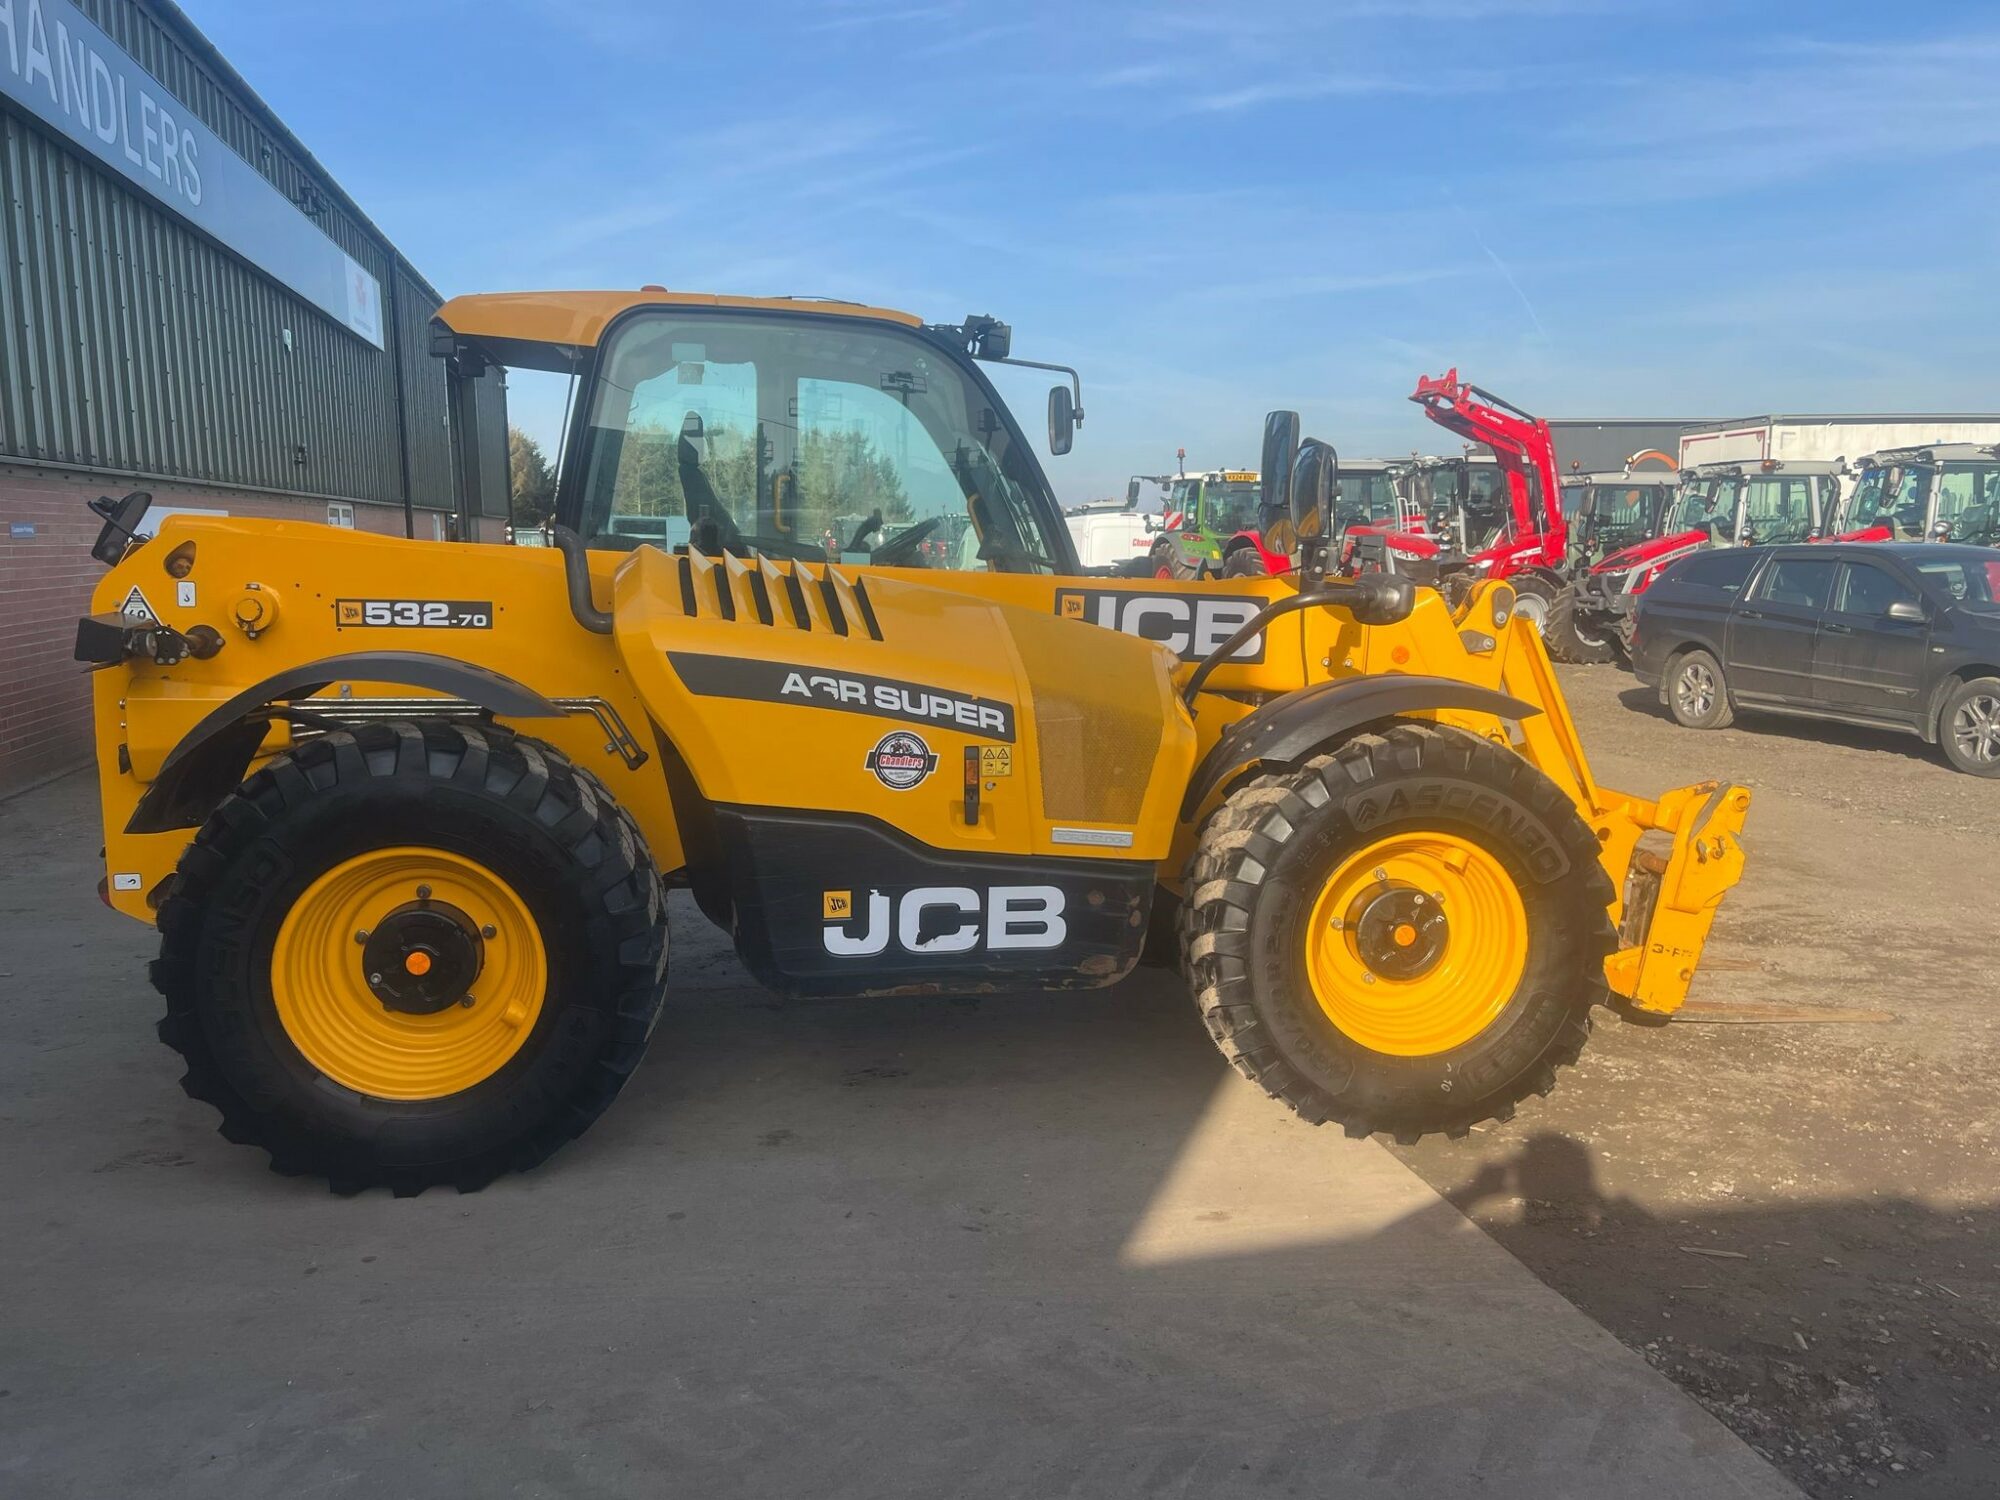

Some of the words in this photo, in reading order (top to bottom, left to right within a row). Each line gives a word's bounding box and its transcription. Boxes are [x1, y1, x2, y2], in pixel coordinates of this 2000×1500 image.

[365, 602, 487, 627] 532-70
[873, 685, 1005, 733] SUPER
[880, 755, 923, 768] Chandlers
[1382, 784, 1562, 877] ASCENSO
[823, 886, 1067, 955] JCB
[830, 895, 849, 913] JCB
